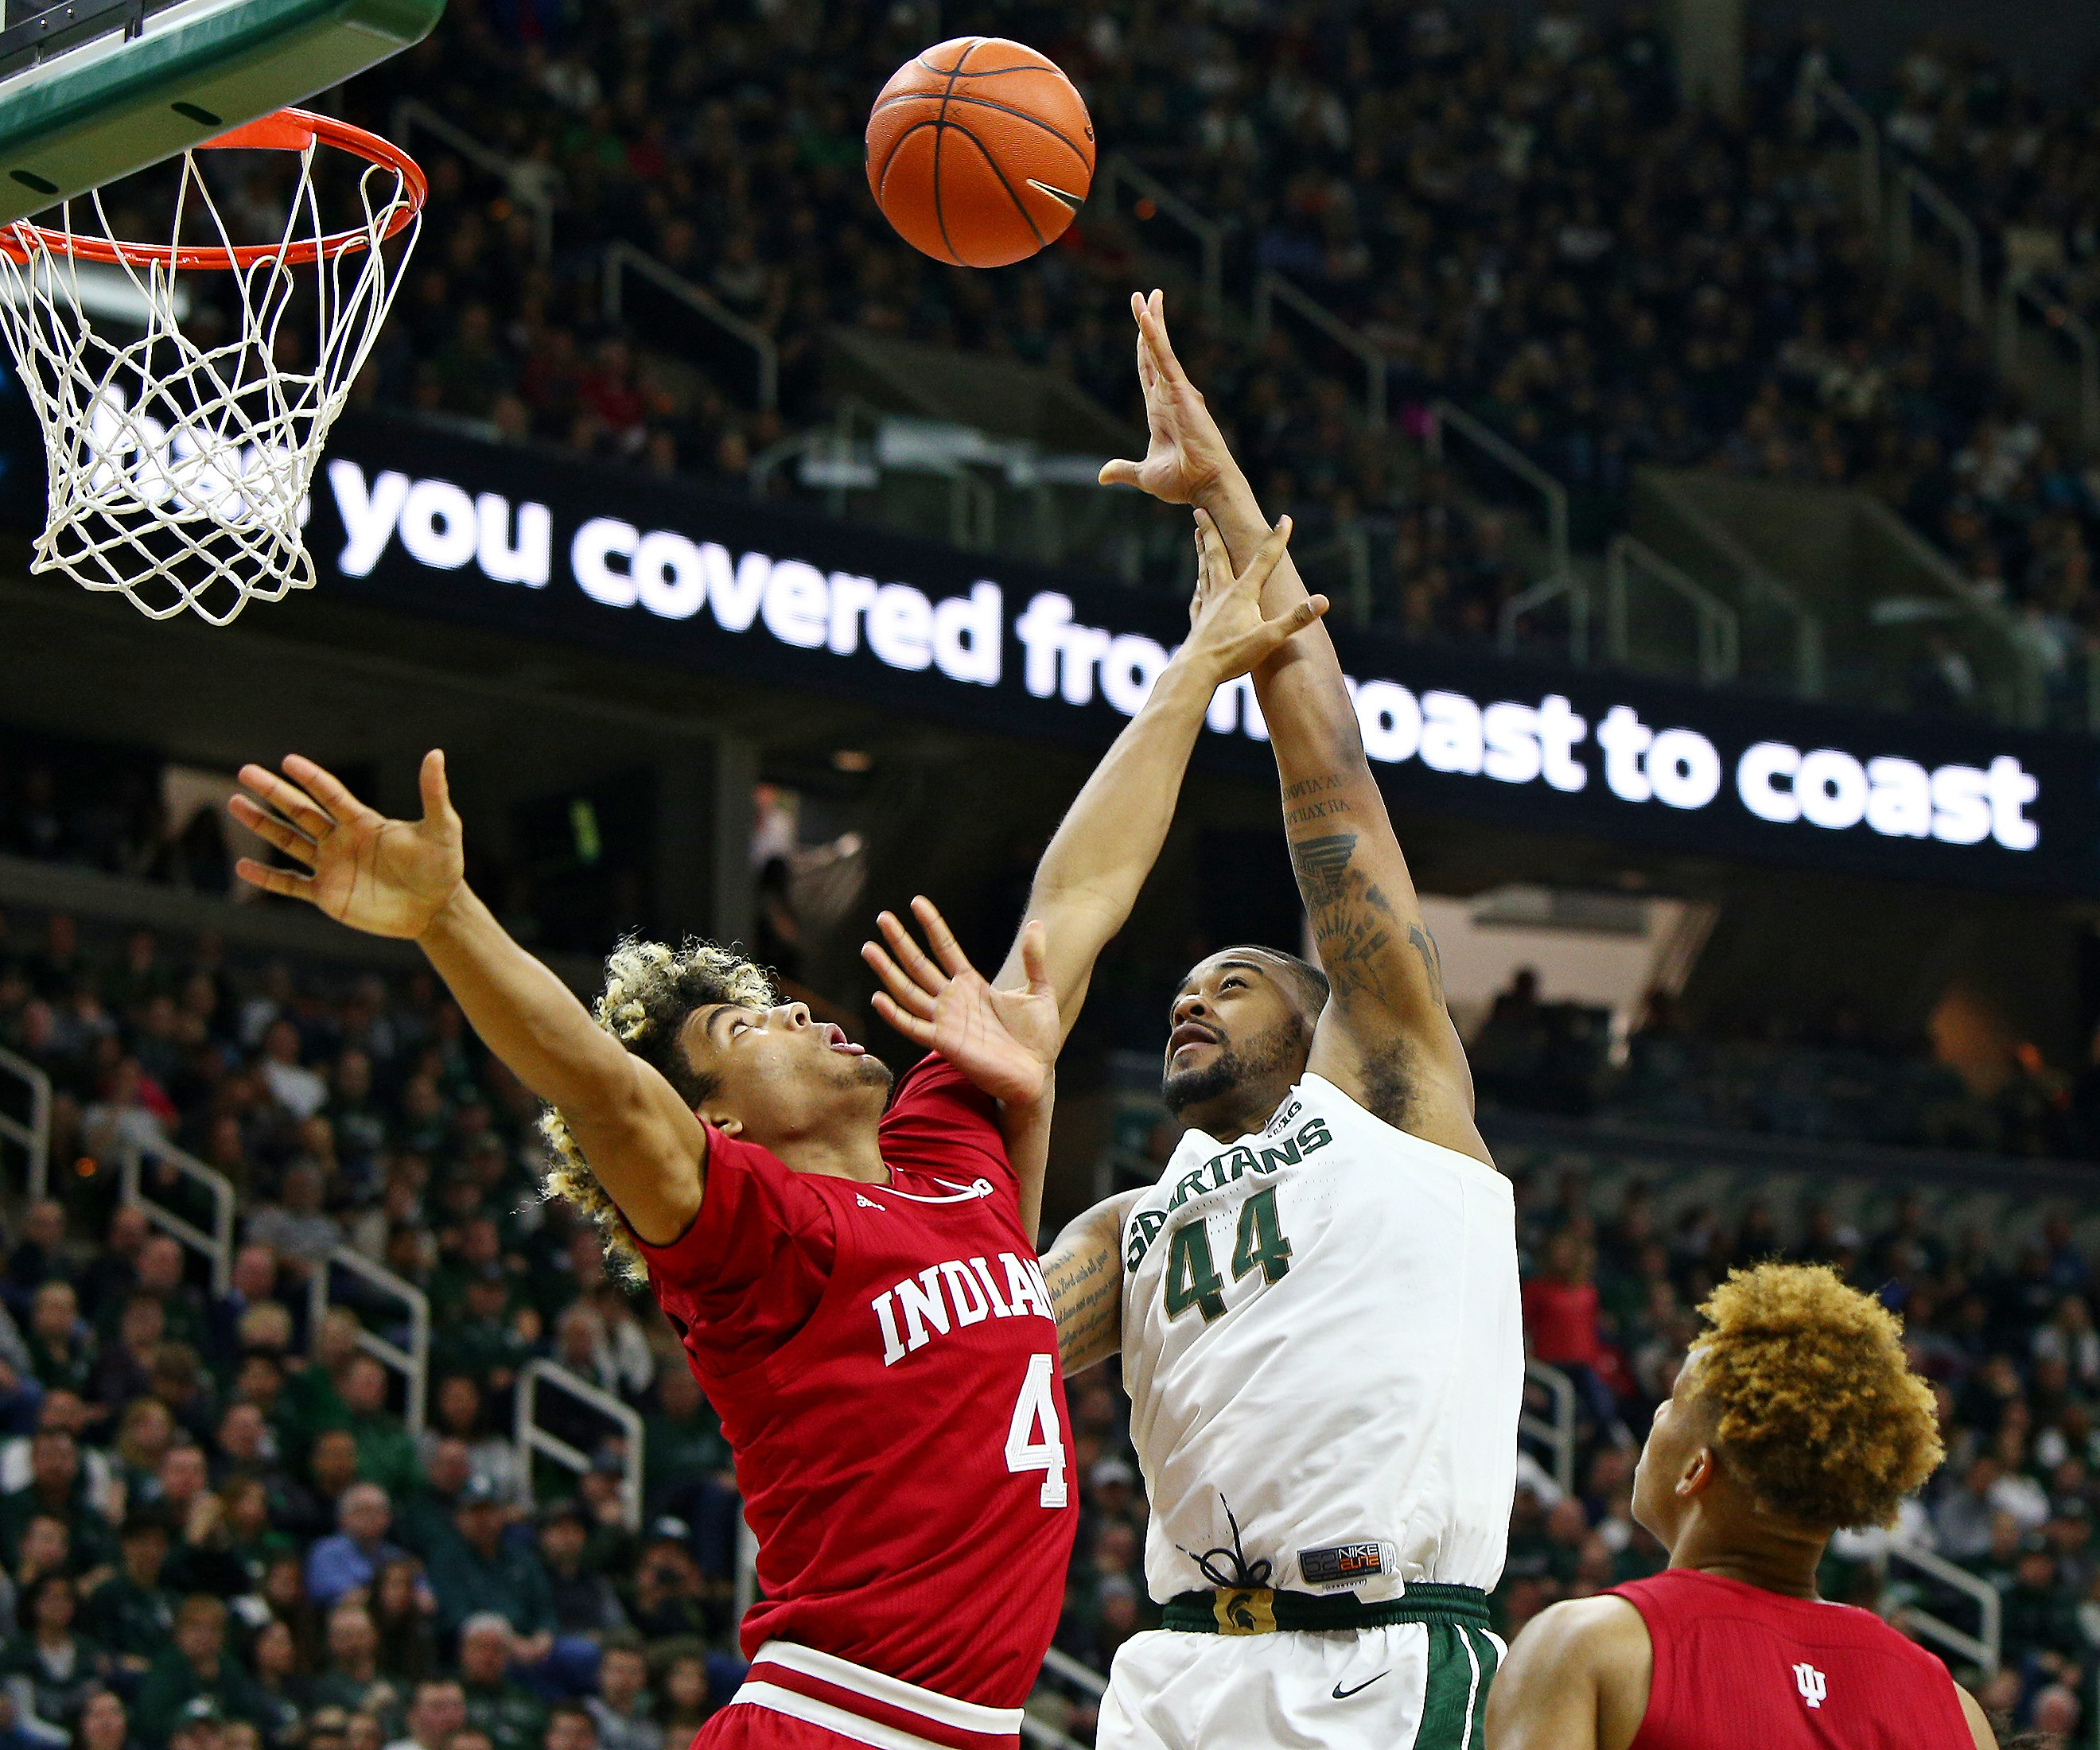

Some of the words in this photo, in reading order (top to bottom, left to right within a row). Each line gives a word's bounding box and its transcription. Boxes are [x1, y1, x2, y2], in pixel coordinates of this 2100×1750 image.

[329, 457, 553, 589] you
[570, 515, 1005, 689] covered
[1596, 703, 1721, 811] to
[1736, 740, 2040, 852] coast
[1163, 1184, 1293, 1326] 44
[1004, 1353, 1068, 1508] 4
[1338, 1543, 1379, 1559] NIKE
